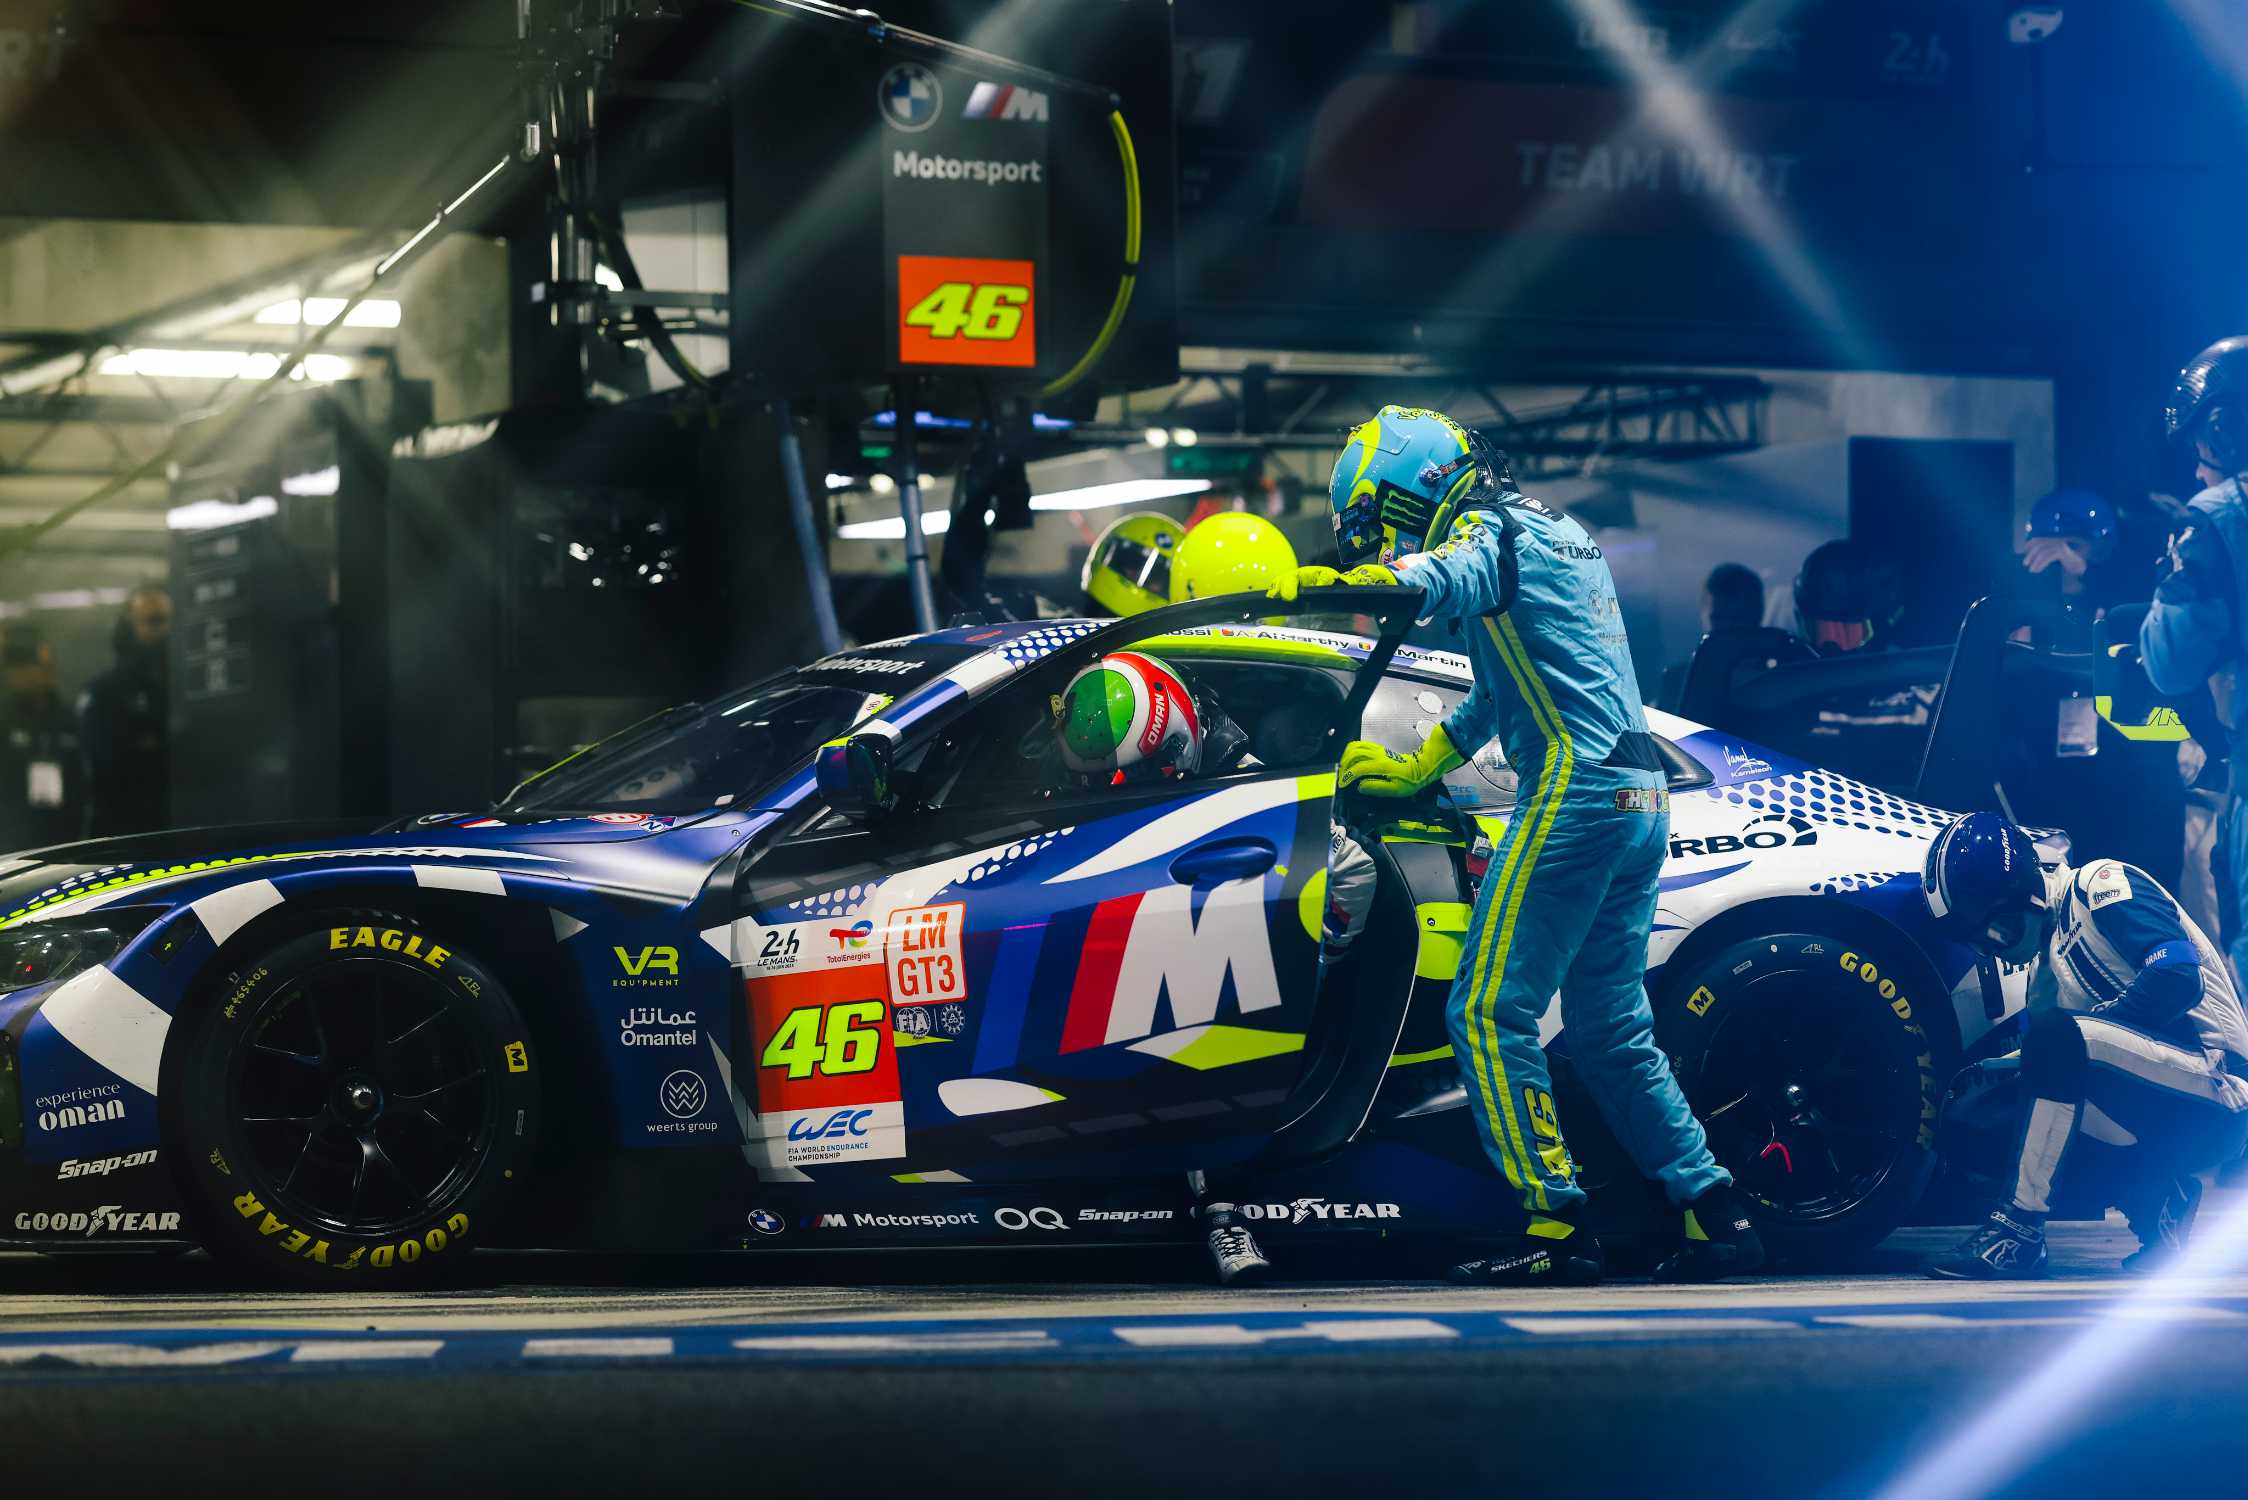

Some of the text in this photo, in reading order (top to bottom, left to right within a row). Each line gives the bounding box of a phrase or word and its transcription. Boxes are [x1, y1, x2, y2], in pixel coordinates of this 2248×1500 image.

[894, 151, 1042, 185] Motorsport
[1517, 142, 1661, 193] TEAM
[905, 282, 1030, 340] 46
[1397, 649, 1466, 669] Martin
[1146, 692, 1168, 745] OMAN
[1665, 835, 1787, 858] RBO
[903, 911, 948, 952] LM
[329, 926, 452, 970] EAGLE
[826, 952, 872, 964] TotalEnergies
[612, 946, 679, 976] VR
[757, 958, 769, 967] LE
[770, 955, 797, 966] MANS
[612, 979, 680, 987] EQUIPMENT
[898, 954, 956, 997] GT3
[620, 1007, 697, 1029] عمانتل
[620, 1029, 697, 1046] Omantel
[760, 998, 886, 1081] 46
[35, 1081, 121, 1109] experience
[38, 1098, 126, 1131] oman
[787, 1109, 873, 1142] WEC
[646, 1121, 718, 1133] weerts group
[788, 1152, 841, 1162] CHAMPIONSHIP
[800, 1145, 826, 1153] WORLD
[826, 1142, 869, 1152] ENDURANCE
[57, 1149, 158, 1181] Snap-on
[853, 1211, 979, 1229] Motorsport
[994, 1206, 1071, 1231] OQ
[1077, 1208, 1173, 1223] Snap-on
[1490, 1250, 1548, 1274] SKECHERS
[1529, 1258, 1551, 1276] 46
